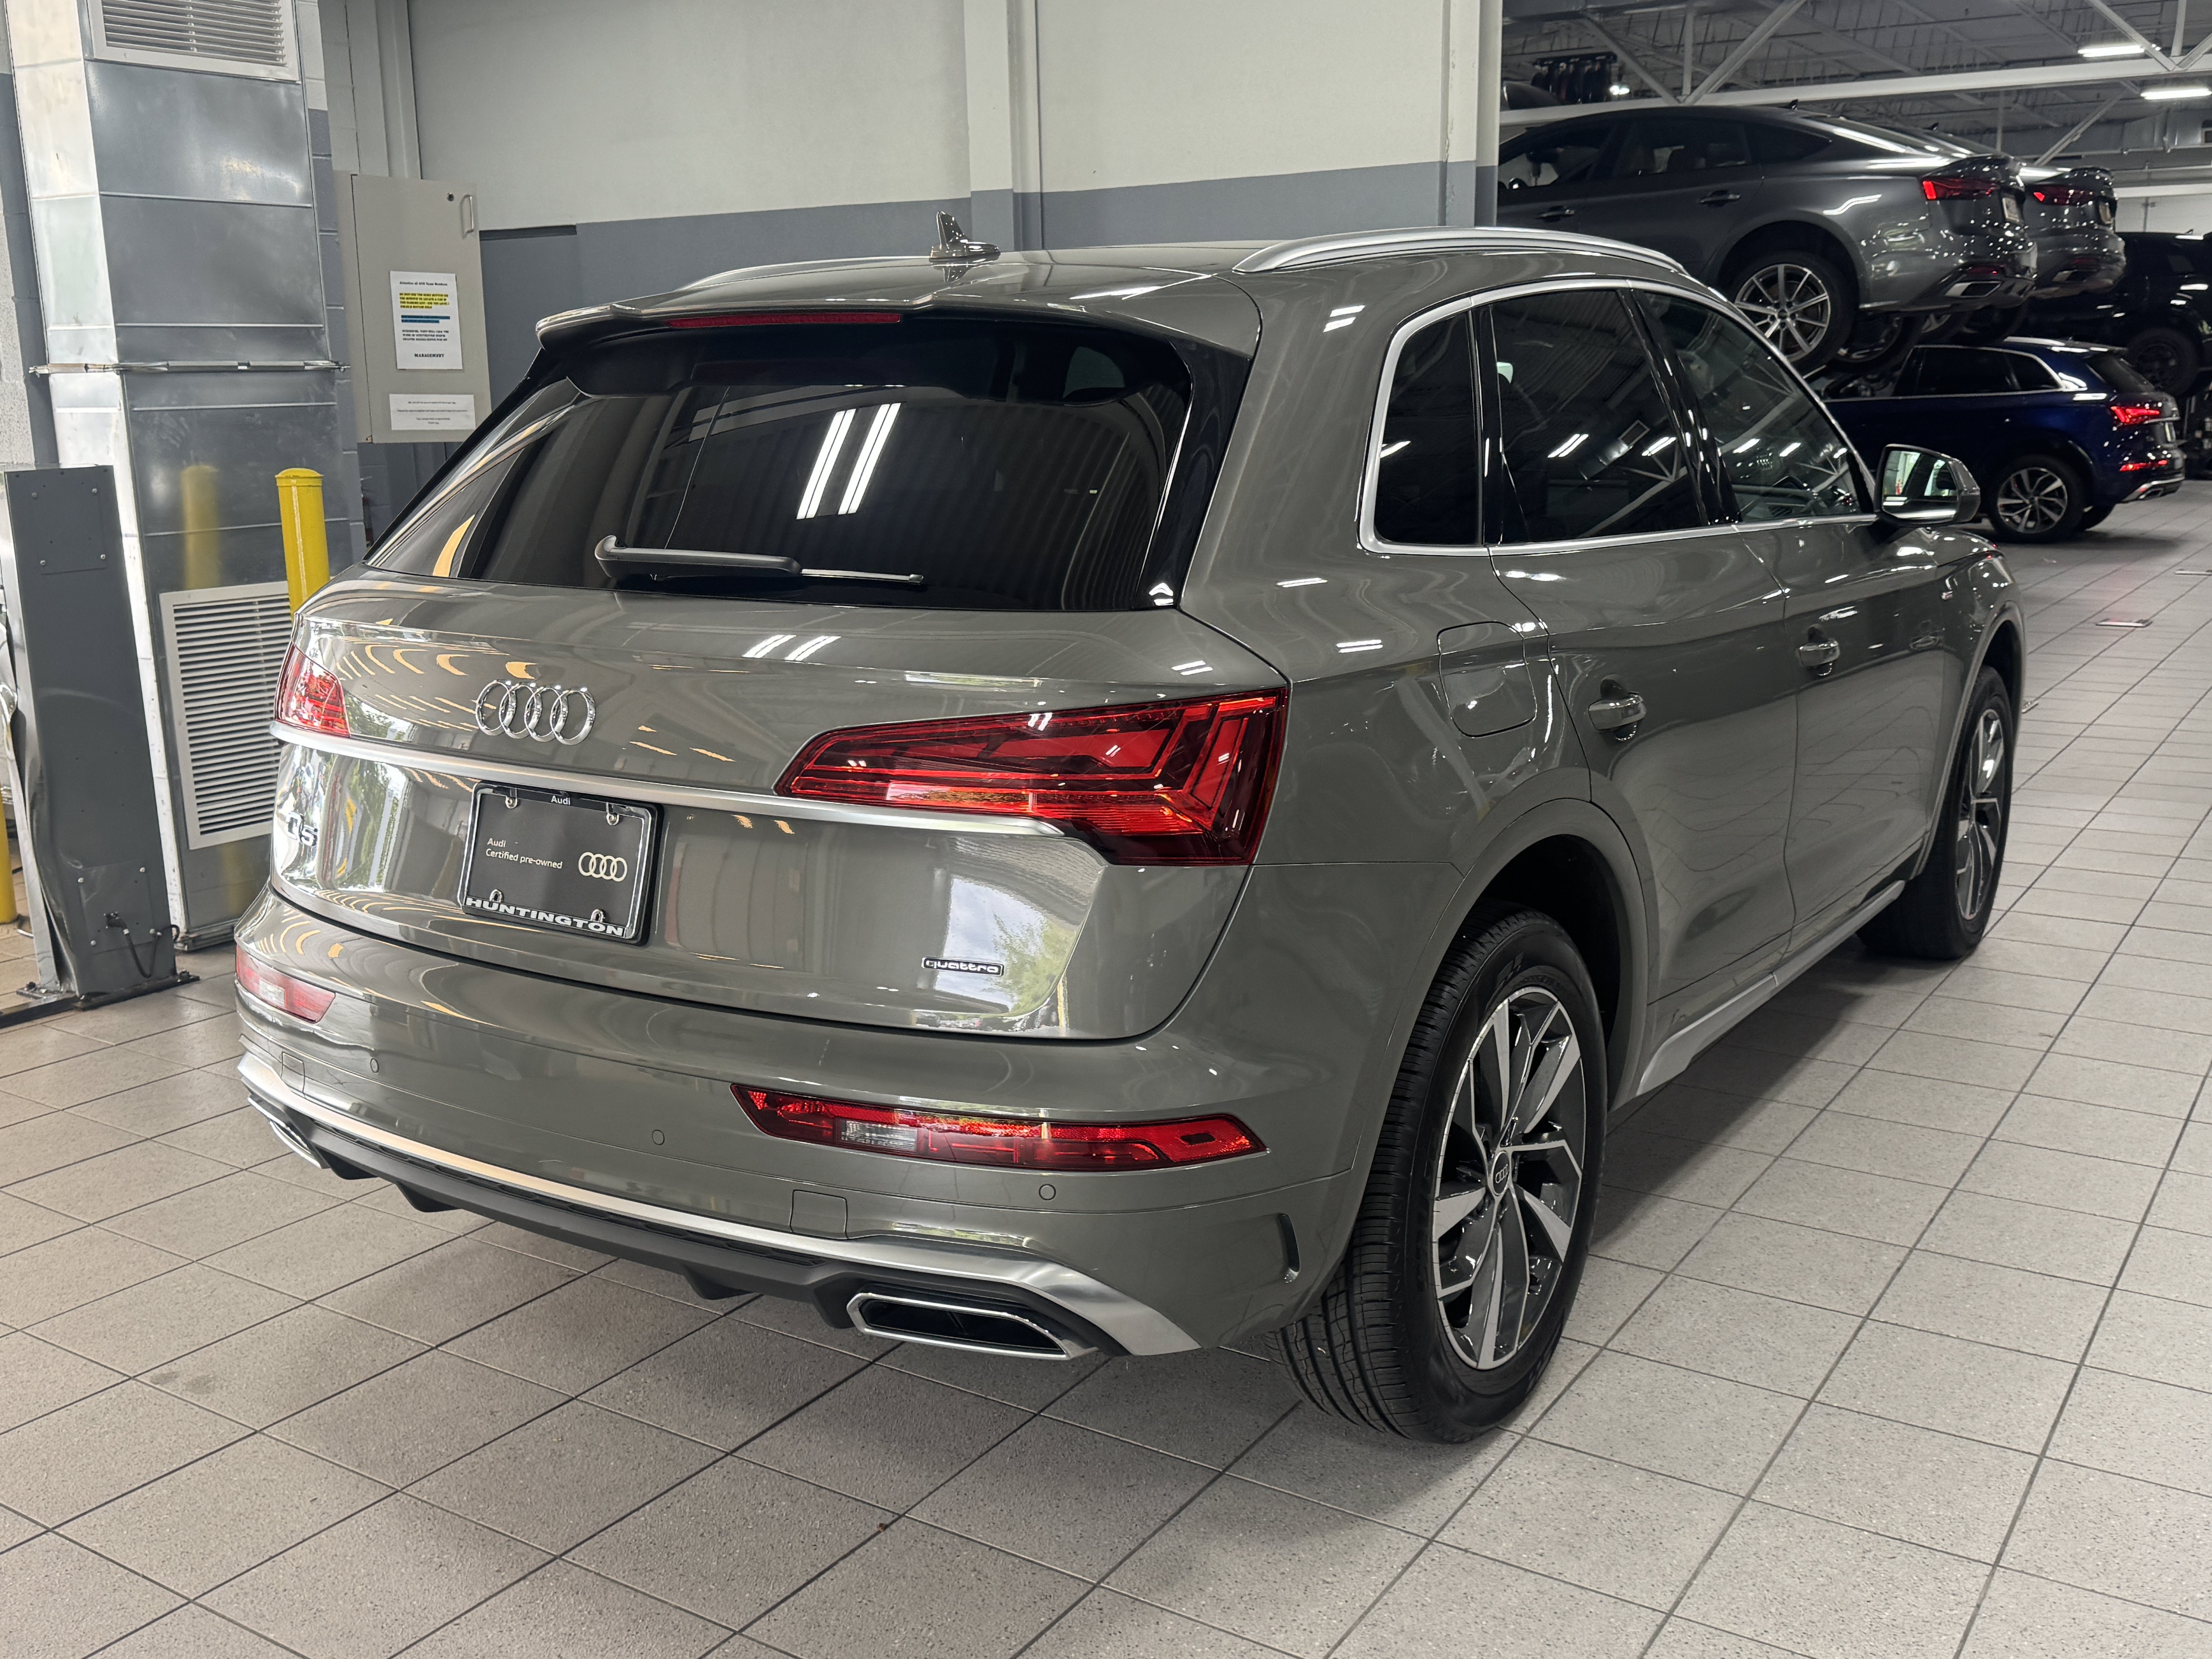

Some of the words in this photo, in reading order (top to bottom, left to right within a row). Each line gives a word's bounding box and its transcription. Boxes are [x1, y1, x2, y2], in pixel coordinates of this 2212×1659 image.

[551, 795, 570, 805] Audi
[487, 838, 506, 847] Audi
[486, 848, 519, 861] Certified
[520, 856, 563, 869] pre-owned
[465, 897, 623, 936] HUNTINGTON
[926, 960, 999, 973] quattro
